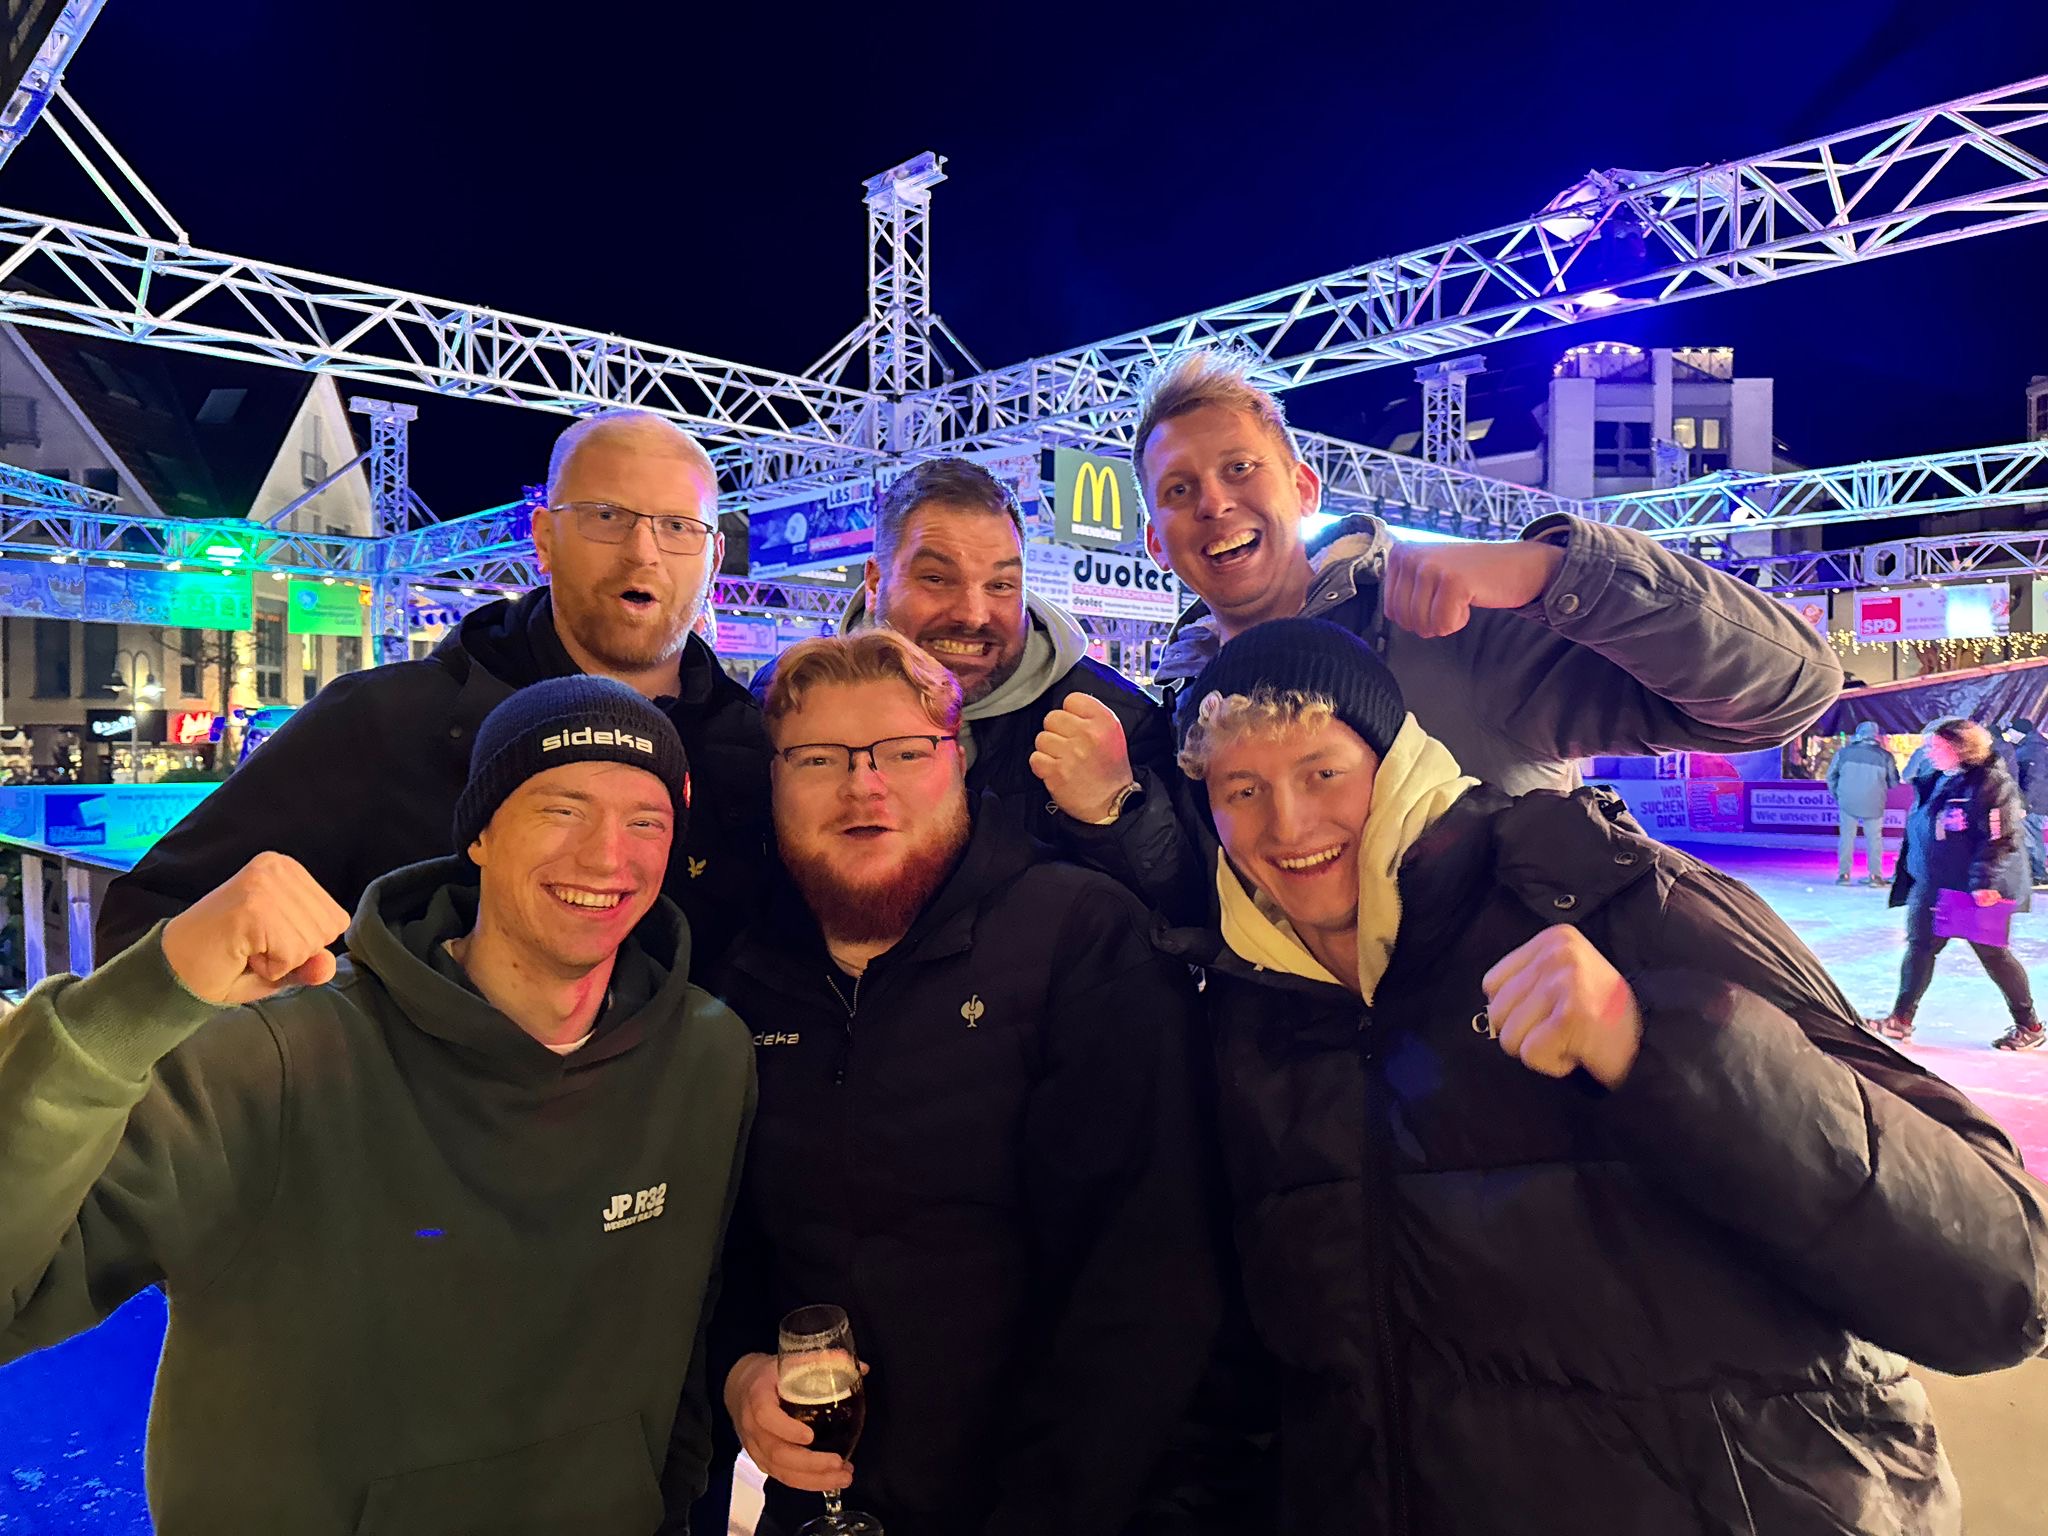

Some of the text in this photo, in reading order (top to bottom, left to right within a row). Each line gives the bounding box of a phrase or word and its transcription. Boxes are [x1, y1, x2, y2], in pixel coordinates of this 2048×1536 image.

[1074, 554, 1173, 592] duotec
[1862, 618, 1898, 633] SPD
[542, 726, 653, 754] sideka
[1660, 785, 1682, 798] WIR
[1755, 793, 1795, 805] Einfach
[1798, 795, 1824, 805] cool
[1640, 800, 1685, 815] SUCHEN
[1657, 814, 1686, 828] DICH!
[1755, 810, 1777, 822] Wie
[1780, 812, 1819, 822] unsere
[753, 1031, 800, 1046] deka
[603, 1182, 667, 1221] JP R32
